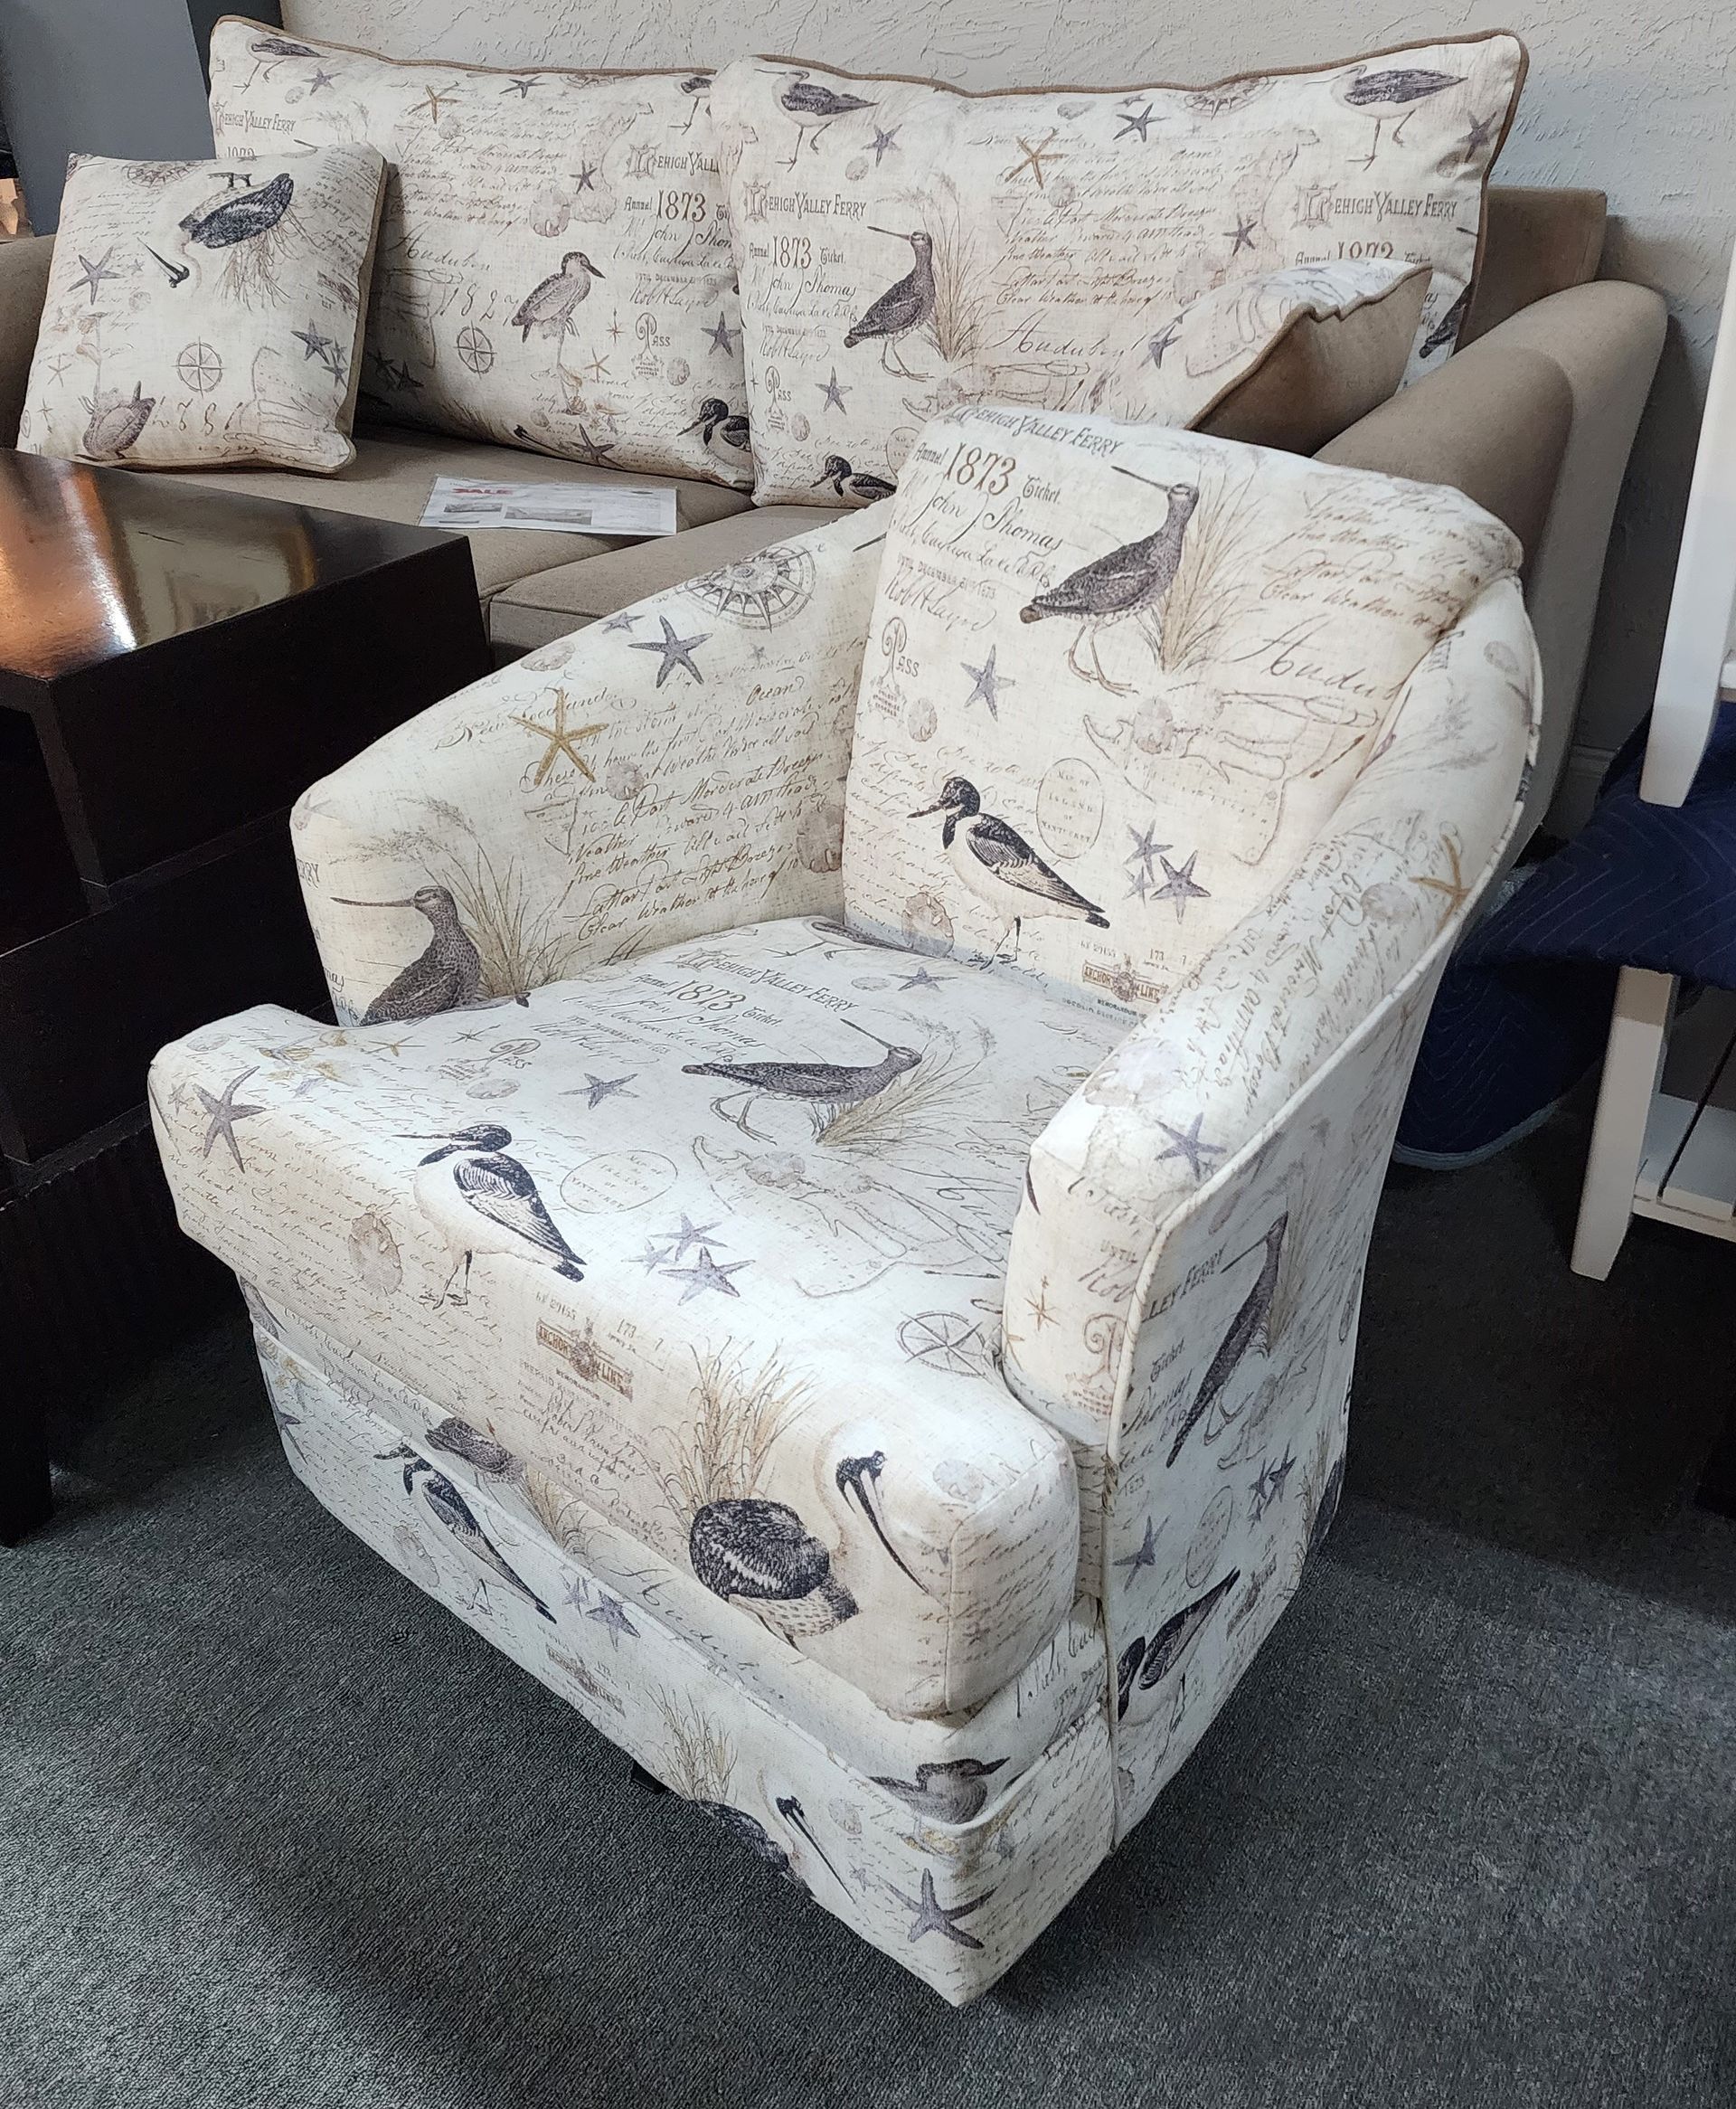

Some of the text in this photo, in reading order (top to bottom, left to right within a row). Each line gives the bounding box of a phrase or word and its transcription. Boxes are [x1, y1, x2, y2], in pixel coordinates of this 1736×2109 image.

[244, 109, 271, 133] VALLEY
[272, 114, 296, 135] FERRY
[627, 145, 720, 177] LEHIGH VALL
[658, 190, 706, 222] 1873
[744, 183, 795, 221] LEHIGH
[795, 191, 832, 220] VALLEY
[833, 194, 866, 221] FERRY
[1294, 184, 1458, 227] LEHIGH VALLEY FERRY
[772, 234, 813, 270] 1873
[1012, 414, 1073, 441] VALLEY
[1070, 427, 1125, 458] FERRY
[944, 441, 1016, 496] 1873
[663, 979, 747, 1011] 1873
[678, 949, 859, 1013] LEHIGH VALLEY FERRY
